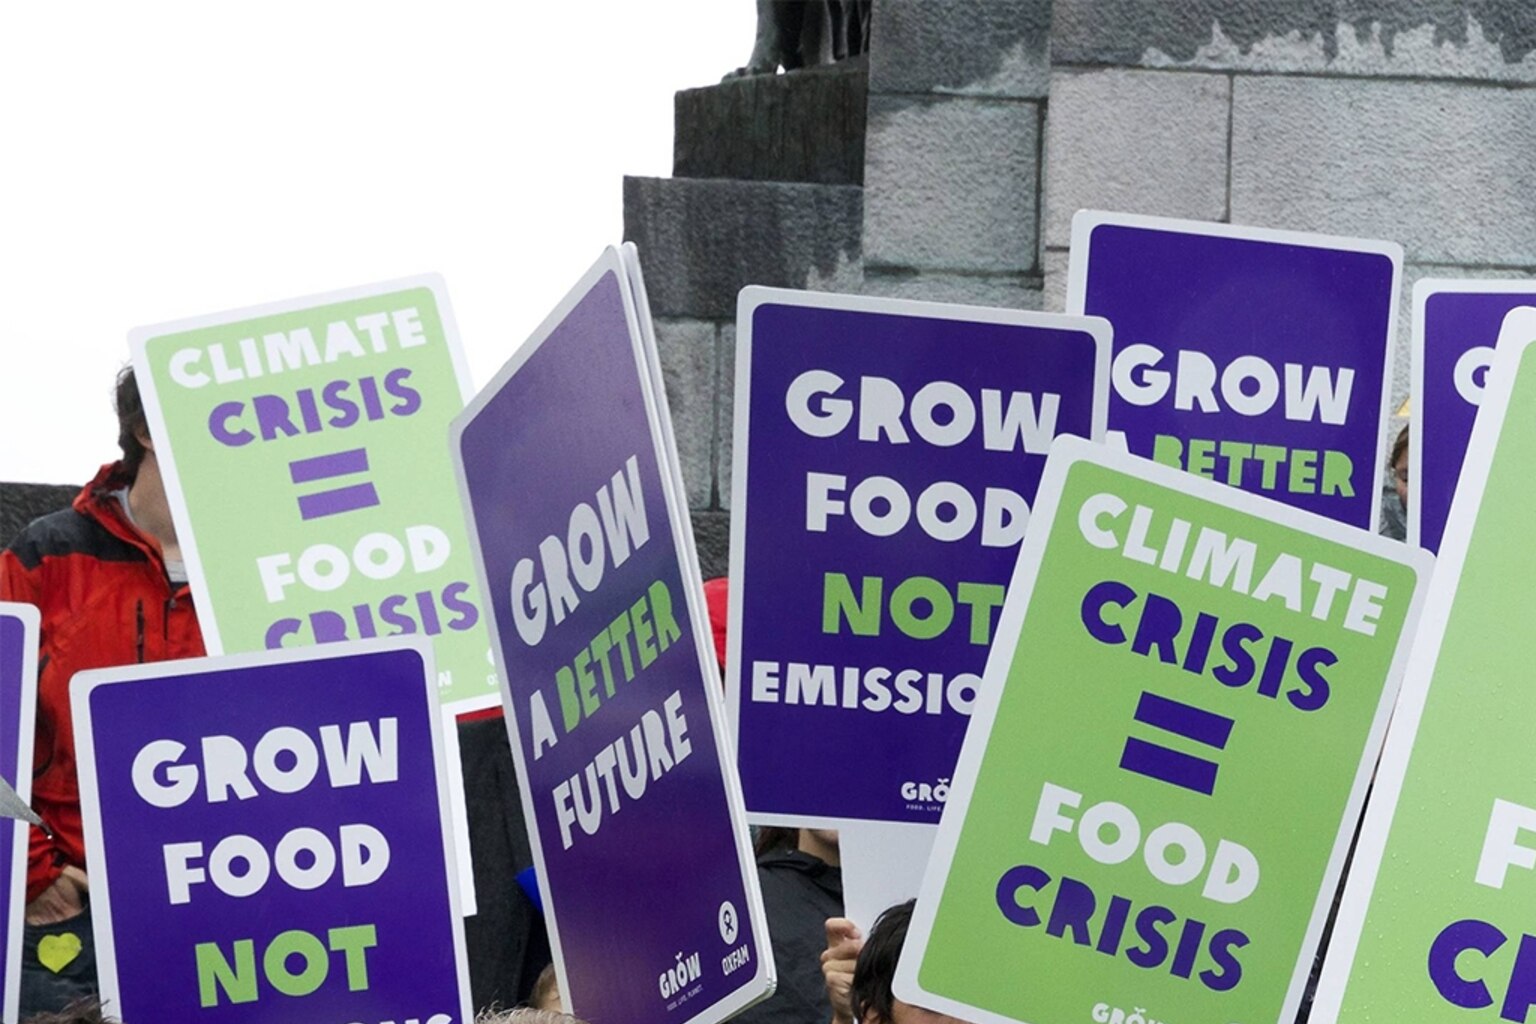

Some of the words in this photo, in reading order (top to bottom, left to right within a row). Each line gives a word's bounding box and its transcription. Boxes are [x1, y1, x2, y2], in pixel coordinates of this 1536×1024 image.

[169, 307, 427, 389] CLIMATE
[1112, 343, 1355, 426] GROW
[208, 367, 422, 447] CRISIS
[785, 369, 1061, 456] GROW
[1153, 434, 1355, 497] BETTER
[511, 455, 651, 646] GROW
[806, 471, 1031, 548] FOOD
[257, 524, 451, 602] FOOD
[1078, 493, 1388, 636] CLIMATE
[822, 572, 1005, 645] NOT
[1081, 581, 1339, 711] CRISIS
[533, 690, 558, 760] A
[556, 580, 682, 732] BETTER
[752, 660, 983, 716] EMISSIO
[131, 717, 398, 808] GROW
[552, 691, 692, 851] FUTURE
[901, 778, 950, 802] GRO
[163, 824, 390, 904] FOOD
[1029, 782, 1260, 904] FOOD
[195, 924, 377, 1008] NOT
[721, 944, 750, 976] OXFAM
[995, 865, 1251, 992] CRISIS
[659, 951, 702, 999] GROW
